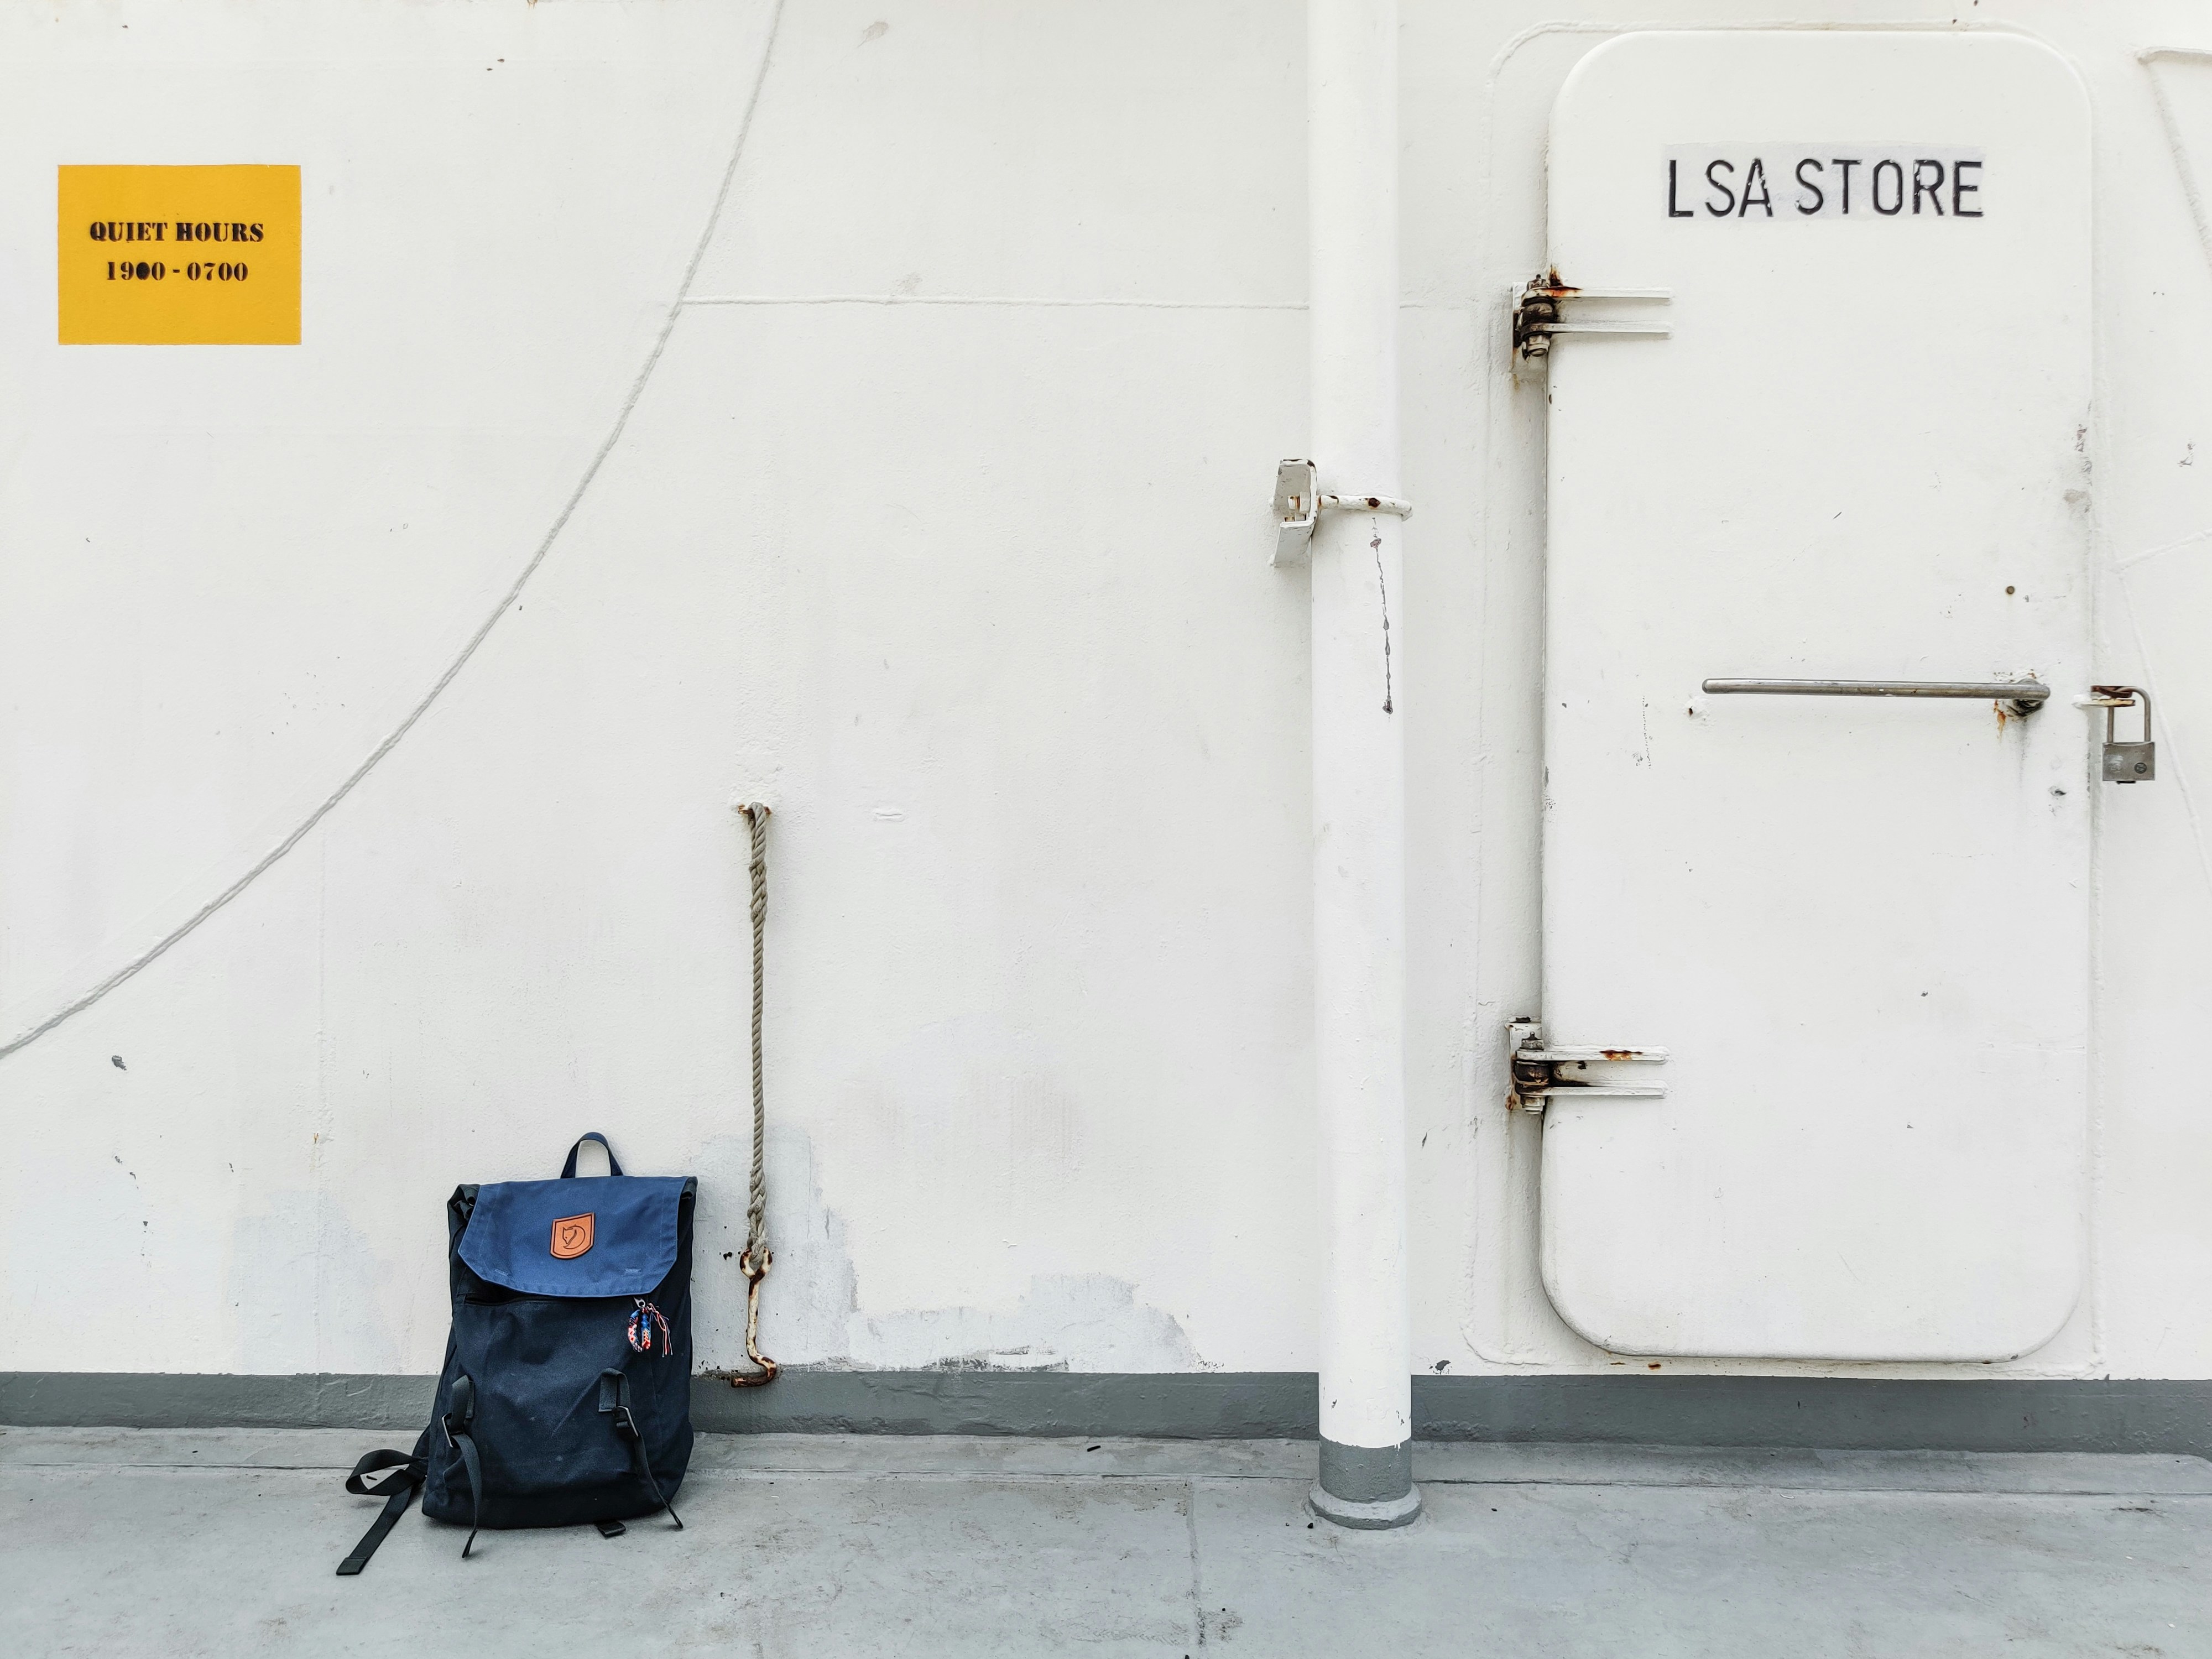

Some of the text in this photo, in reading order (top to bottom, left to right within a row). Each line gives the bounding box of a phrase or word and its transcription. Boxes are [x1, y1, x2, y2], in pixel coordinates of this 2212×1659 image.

[1668, 158, 1984, 217] LSA STORE
[90, 222, 264, 242] QUIET HOURS
